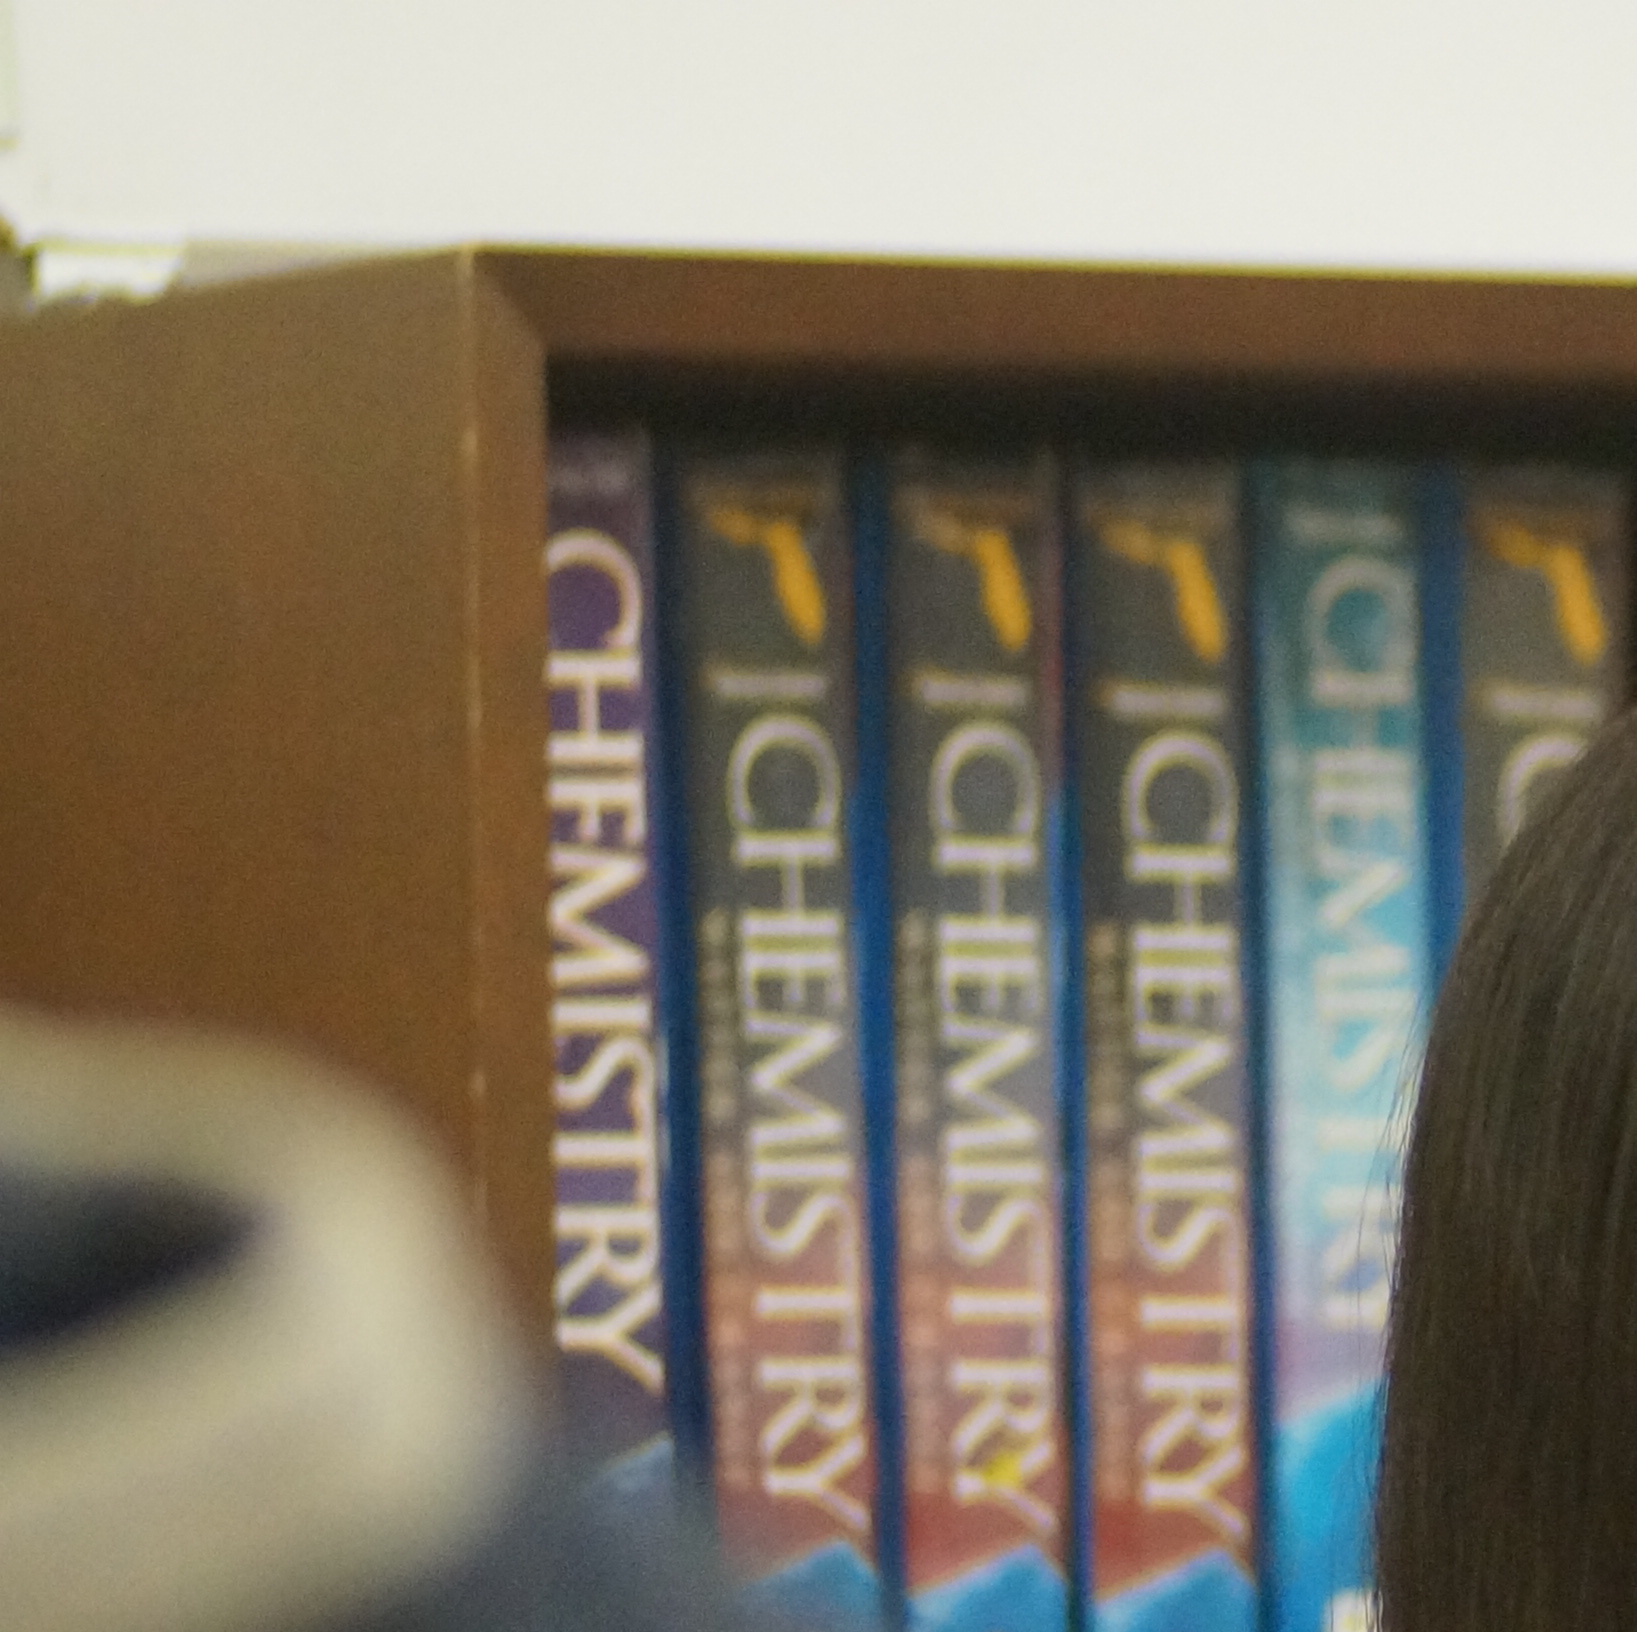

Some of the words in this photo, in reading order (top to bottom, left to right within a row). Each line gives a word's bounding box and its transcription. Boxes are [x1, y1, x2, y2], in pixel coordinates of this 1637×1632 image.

[726, 711, 870, 1531] CHEMISTRY
[929, 719, 1060, 1534] CHEMISTRY
[1122, 730, 1250, 1540] CHEMISTRY
